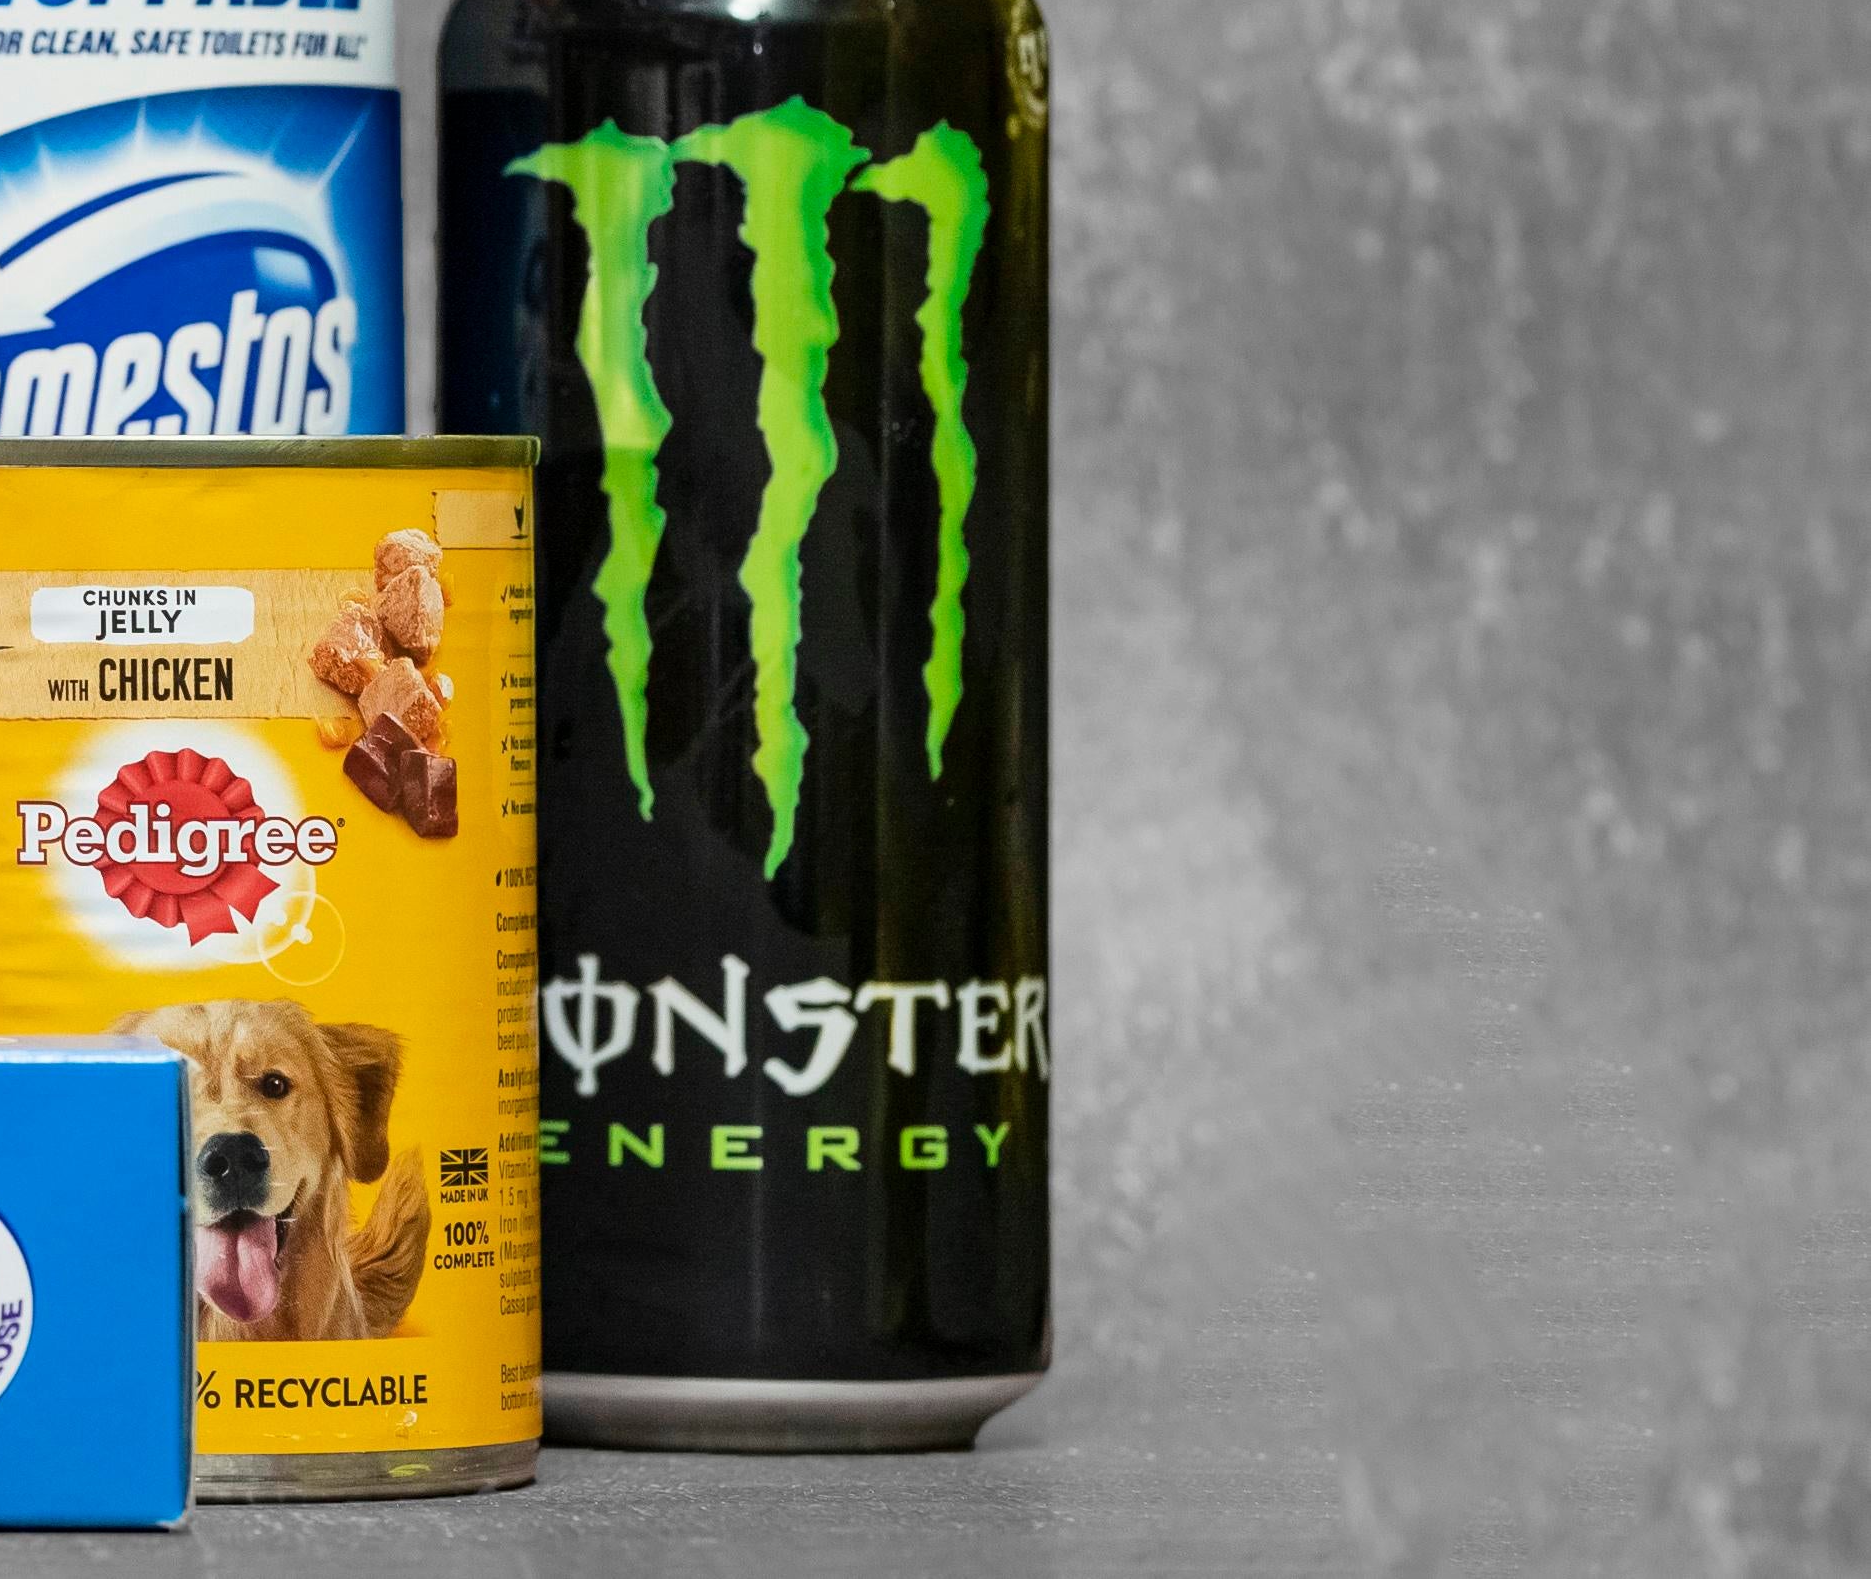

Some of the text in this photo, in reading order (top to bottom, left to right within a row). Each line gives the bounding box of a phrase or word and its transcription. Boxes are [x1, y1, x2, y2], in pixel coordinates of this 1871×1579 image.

[30, 30, 120, 59] CLEAN,
[131, 30, 192, 56] SAFE
[201, 31, 287, 58] TOILETS
[82, 587, 197, 608] CHUNKS IN
[95, 609, 183, 642] JELLY
[48, 657, 235, 703] WITH CHICKEN
[16, 800, 341, 877] Pedigree
[540, 953, 1051, 1097] ONSTER
[537, 1120, 1011, 1171] ENERGY
[440, 1188, 489, 1204] MADE IN UK
[443, 1220, 489, 1247] 100%
[499, 1215, 518, 1234] Iron
[433, 1251, 495, 1271] COMPLETE
[501, 1363, 518, 1384] Best
[234, 1374, 429, 1410] RECYCLABLE
